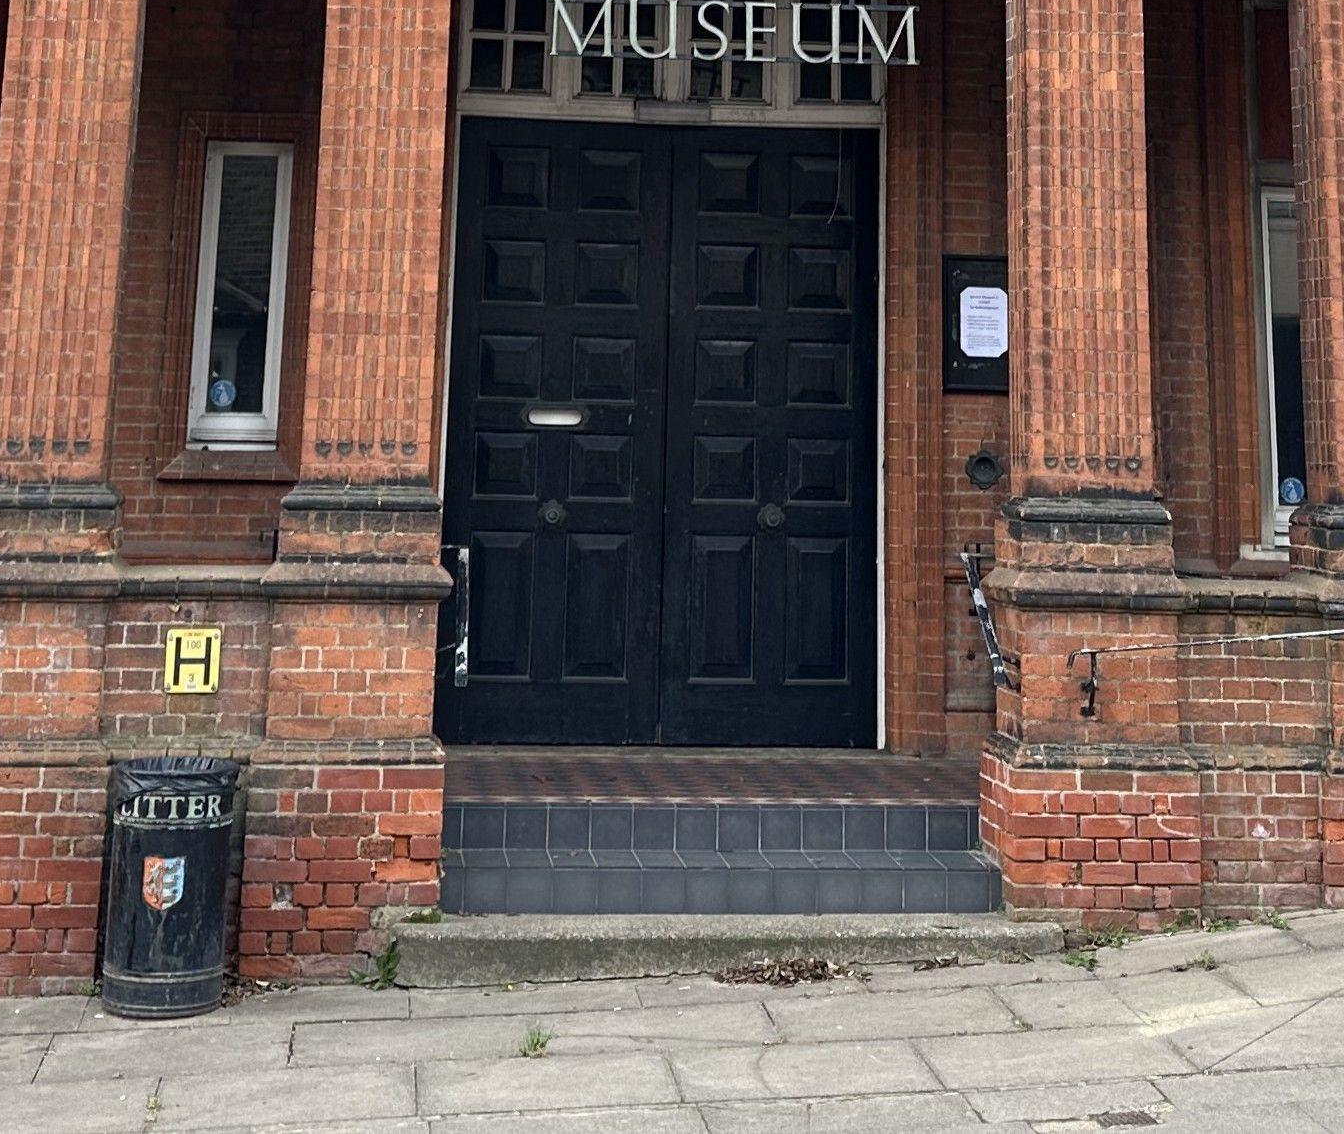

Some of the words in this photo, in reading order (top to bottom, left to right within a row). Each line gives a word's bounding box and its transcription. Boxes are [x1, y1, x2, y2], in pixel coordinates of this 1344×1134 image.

[187, 640, 202, 650] 100
[173, 636, 212, 686] H
[188, 673, 195, 683] 3
[120, 794, 222, 820] LITTER
